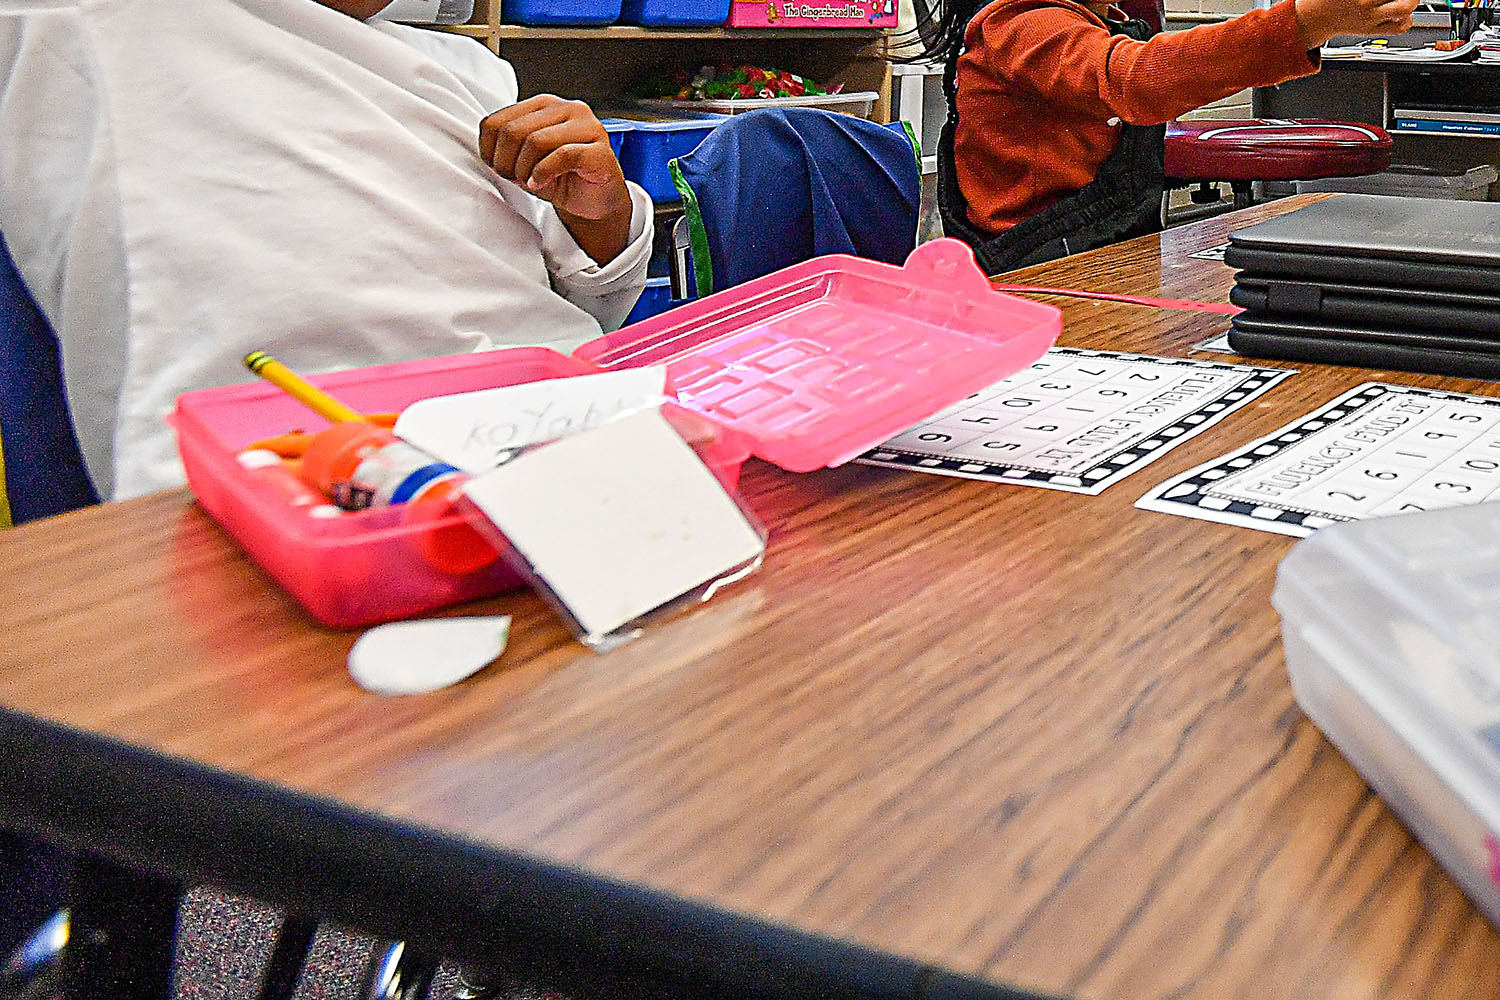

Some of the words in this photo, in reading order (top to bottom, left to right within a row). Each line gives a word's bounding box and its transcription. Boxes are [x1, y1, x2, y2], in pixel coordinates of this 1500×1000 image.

[784, 3, 799, 18] The
[800, 4, 849, 21] Gingerbread
[850, 5, 865, 18] Man
[1077, 368, 1106, 376] 7
[1129, 373, 1160, 381] 2
[1040, 383, 1071, 391] 3
[1098, 389, 1128, 397] 6
[1002, 397, 1042, 408] 10
[961, 416, 999, 425] 4
[1024, 424, 1058, 432] 9
[918, 432, 952, 444] 6
[983, 440, 1021, 452] 5
[1245, 441, 1362, 496] FLUENCY
[1344, 414, 1410, 443] FIND
[1392, 399, 1431, 415] IT
[1328, 491, 1367, 501] 2
[1364, 469, 1398, 480] 6
[1424, 431, 1458, 440] 9
[1449, 412, 1482, 423] 5
[1435, 481, 1472, 494] 3
[1460, 459, 1500, 473] 10
